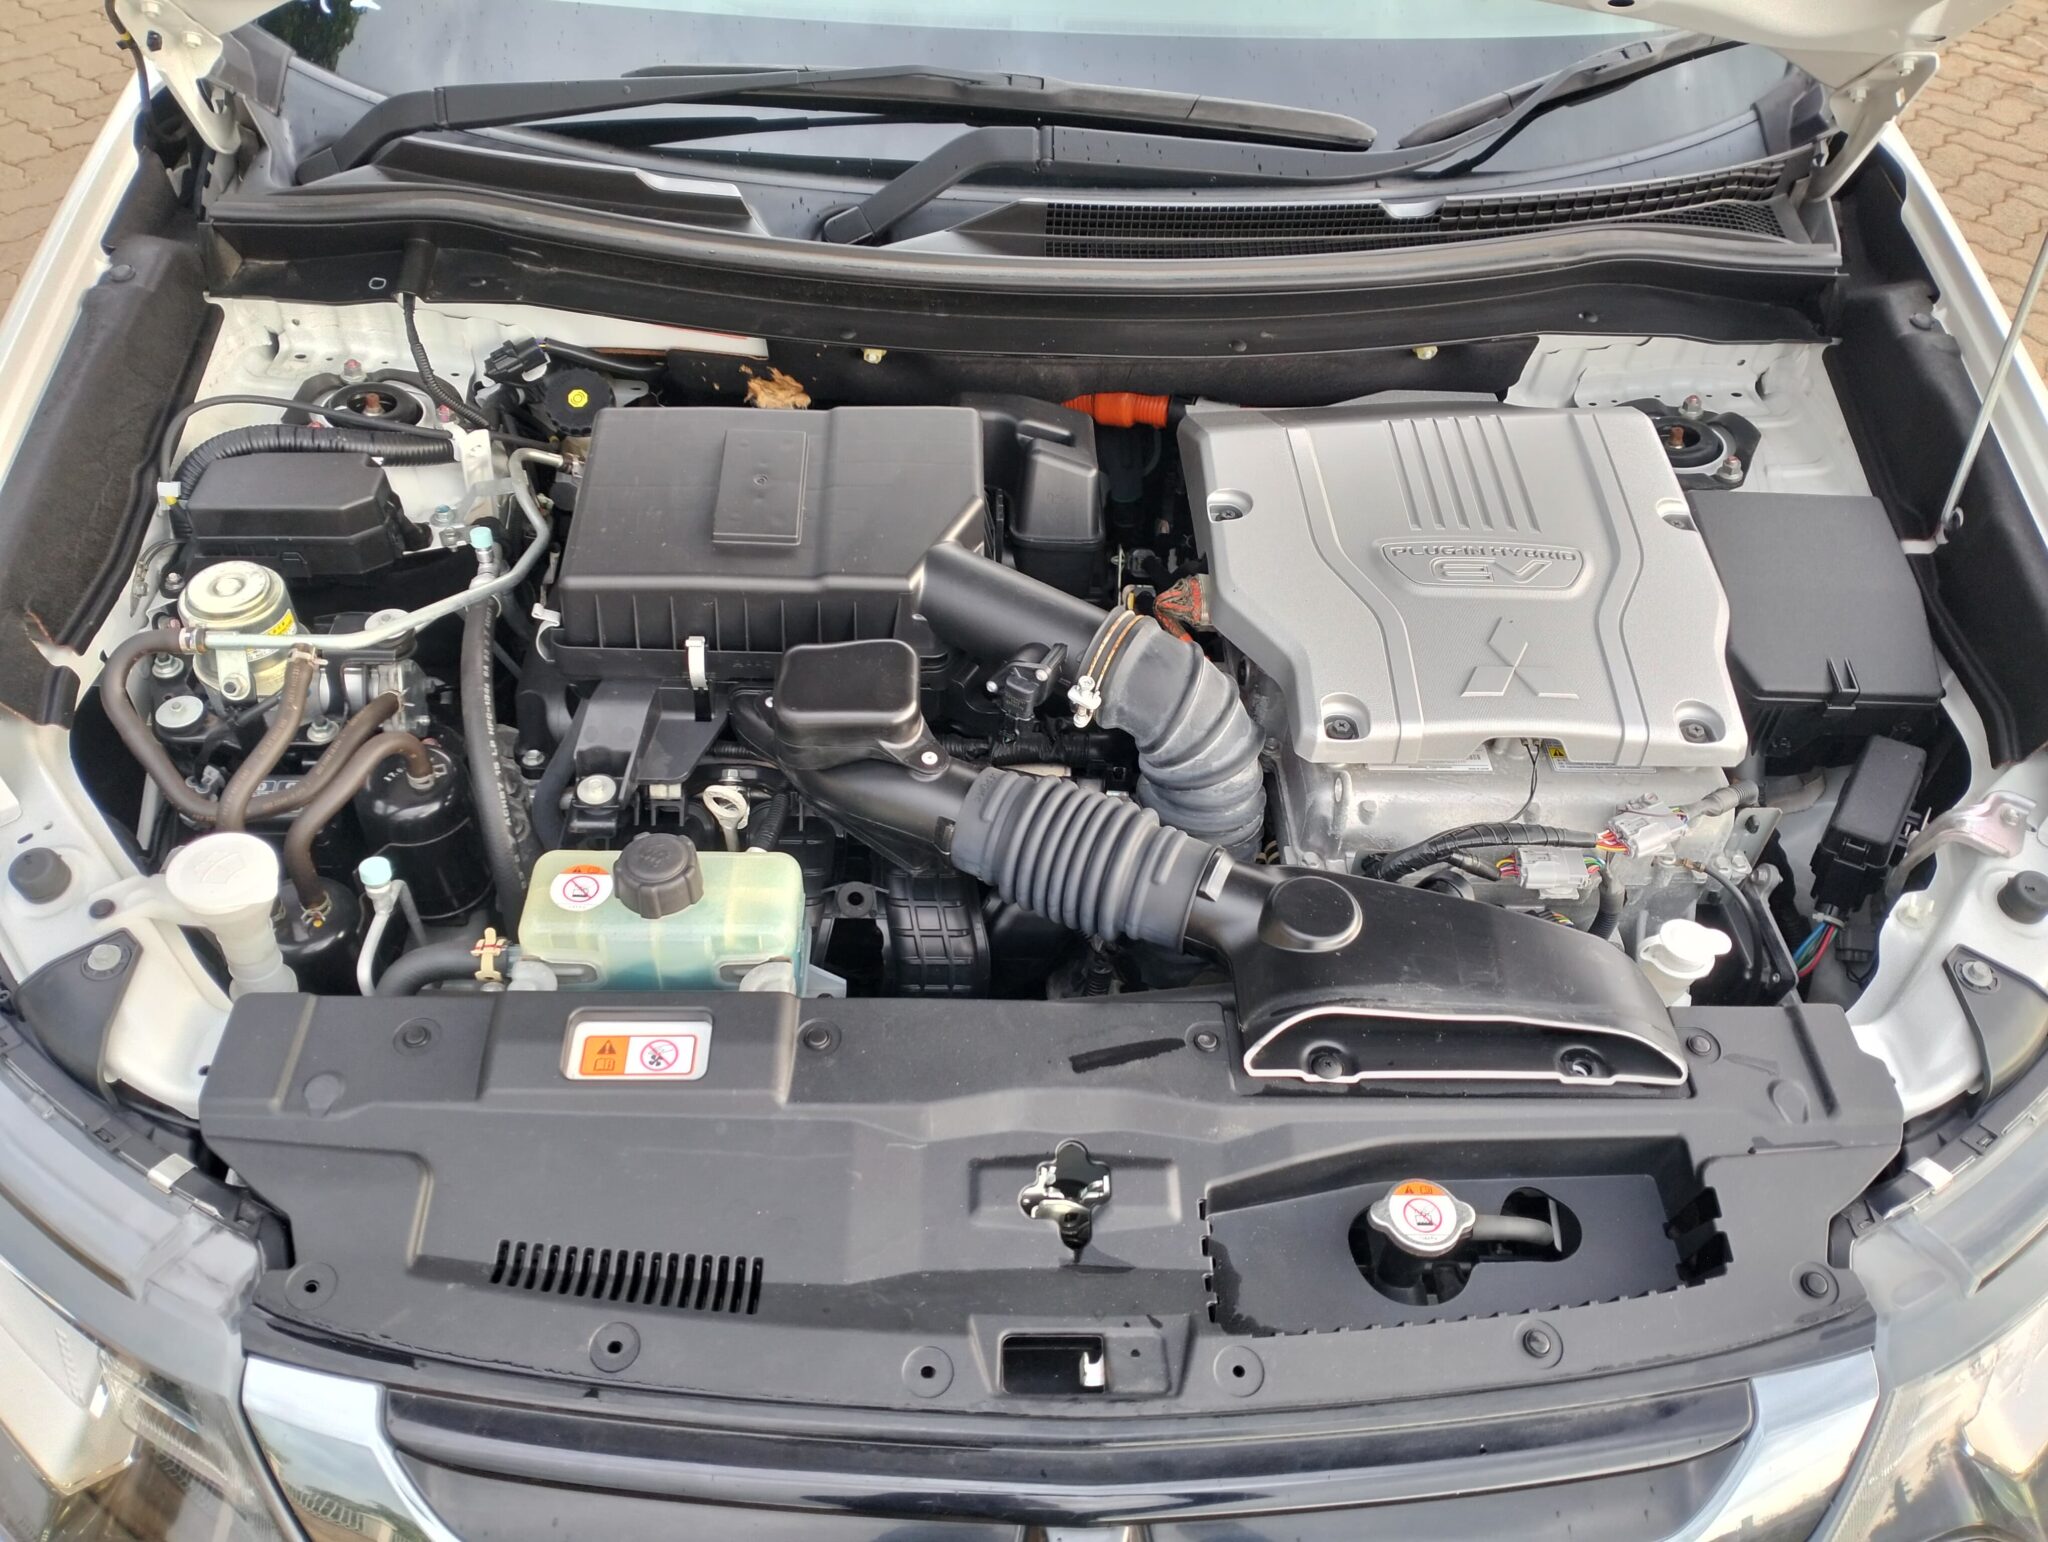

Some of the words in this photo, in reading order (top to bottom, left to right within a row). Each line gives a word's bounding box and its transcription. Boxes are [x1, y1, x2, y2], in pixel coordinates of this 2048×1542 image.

[1391, 545, 1485, 557] PLUG-IN
[1489, 545, 1577, 561] HYBRID
[1430, 557, 1553, 583] EV
